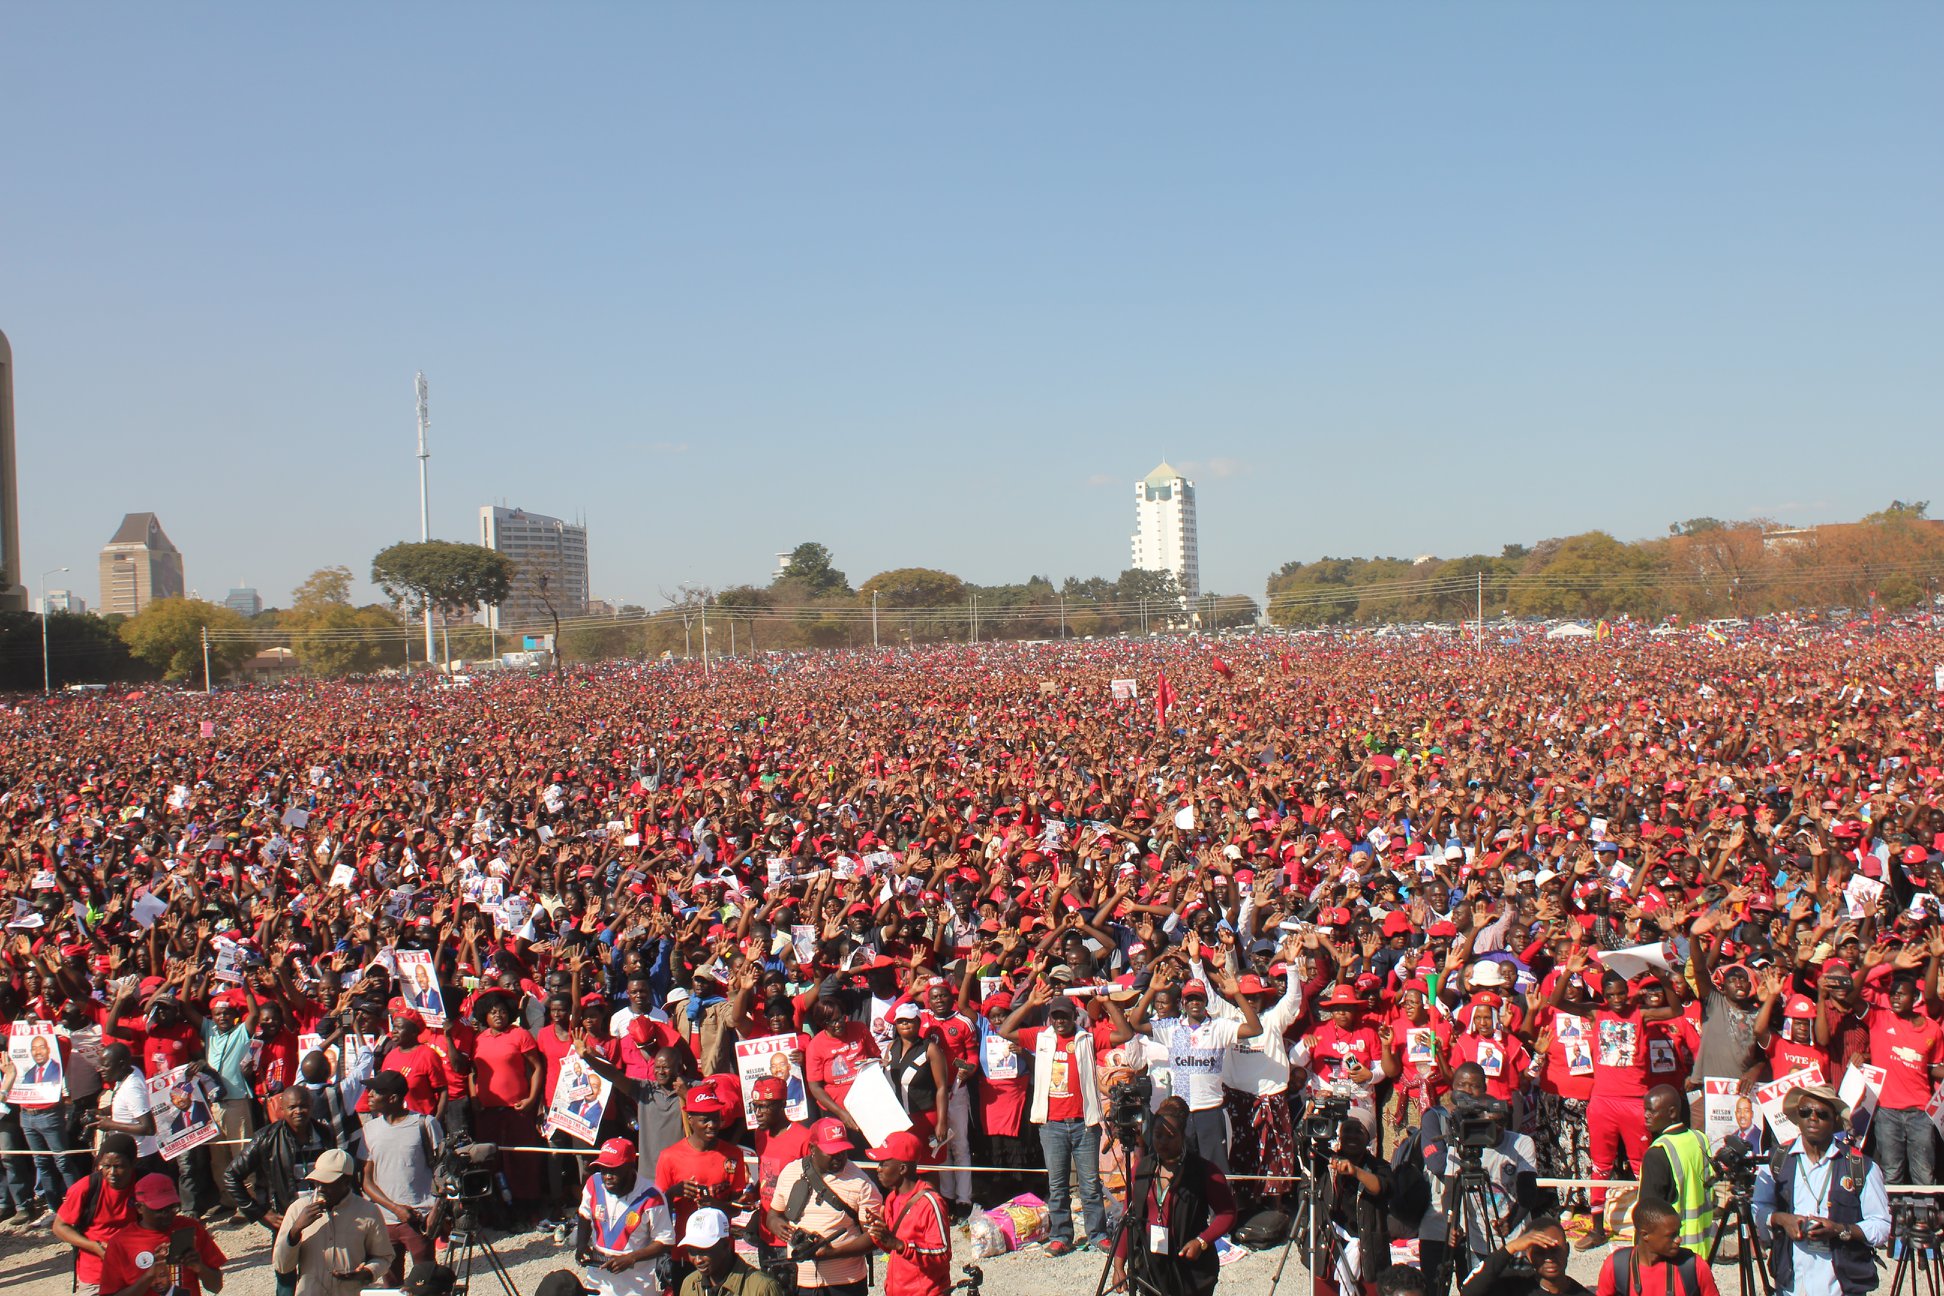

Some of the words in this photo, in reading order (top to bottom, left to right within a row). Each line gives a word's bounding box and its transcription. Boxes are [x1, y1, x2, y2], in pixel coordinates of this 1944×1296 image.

[14, 1023, 49, 1036] VOTE
[744, 1038, 791, 1055] VOTE
[1053, 1051, 1068, 1061] ote
[1174, 1056, 1216, 1068] Cellnet
[1784, 1052, 1809, 1065] VOTE
[745, 1067, 765, 1075] NELSON
[1764, 1071, 1814, 1100] VOTE
[1710, 1114, 1733, 1122] CHAMISA
[164, 1137, 186, 1152] BEHOLD
[185, 1133, 196, 1143] THE
